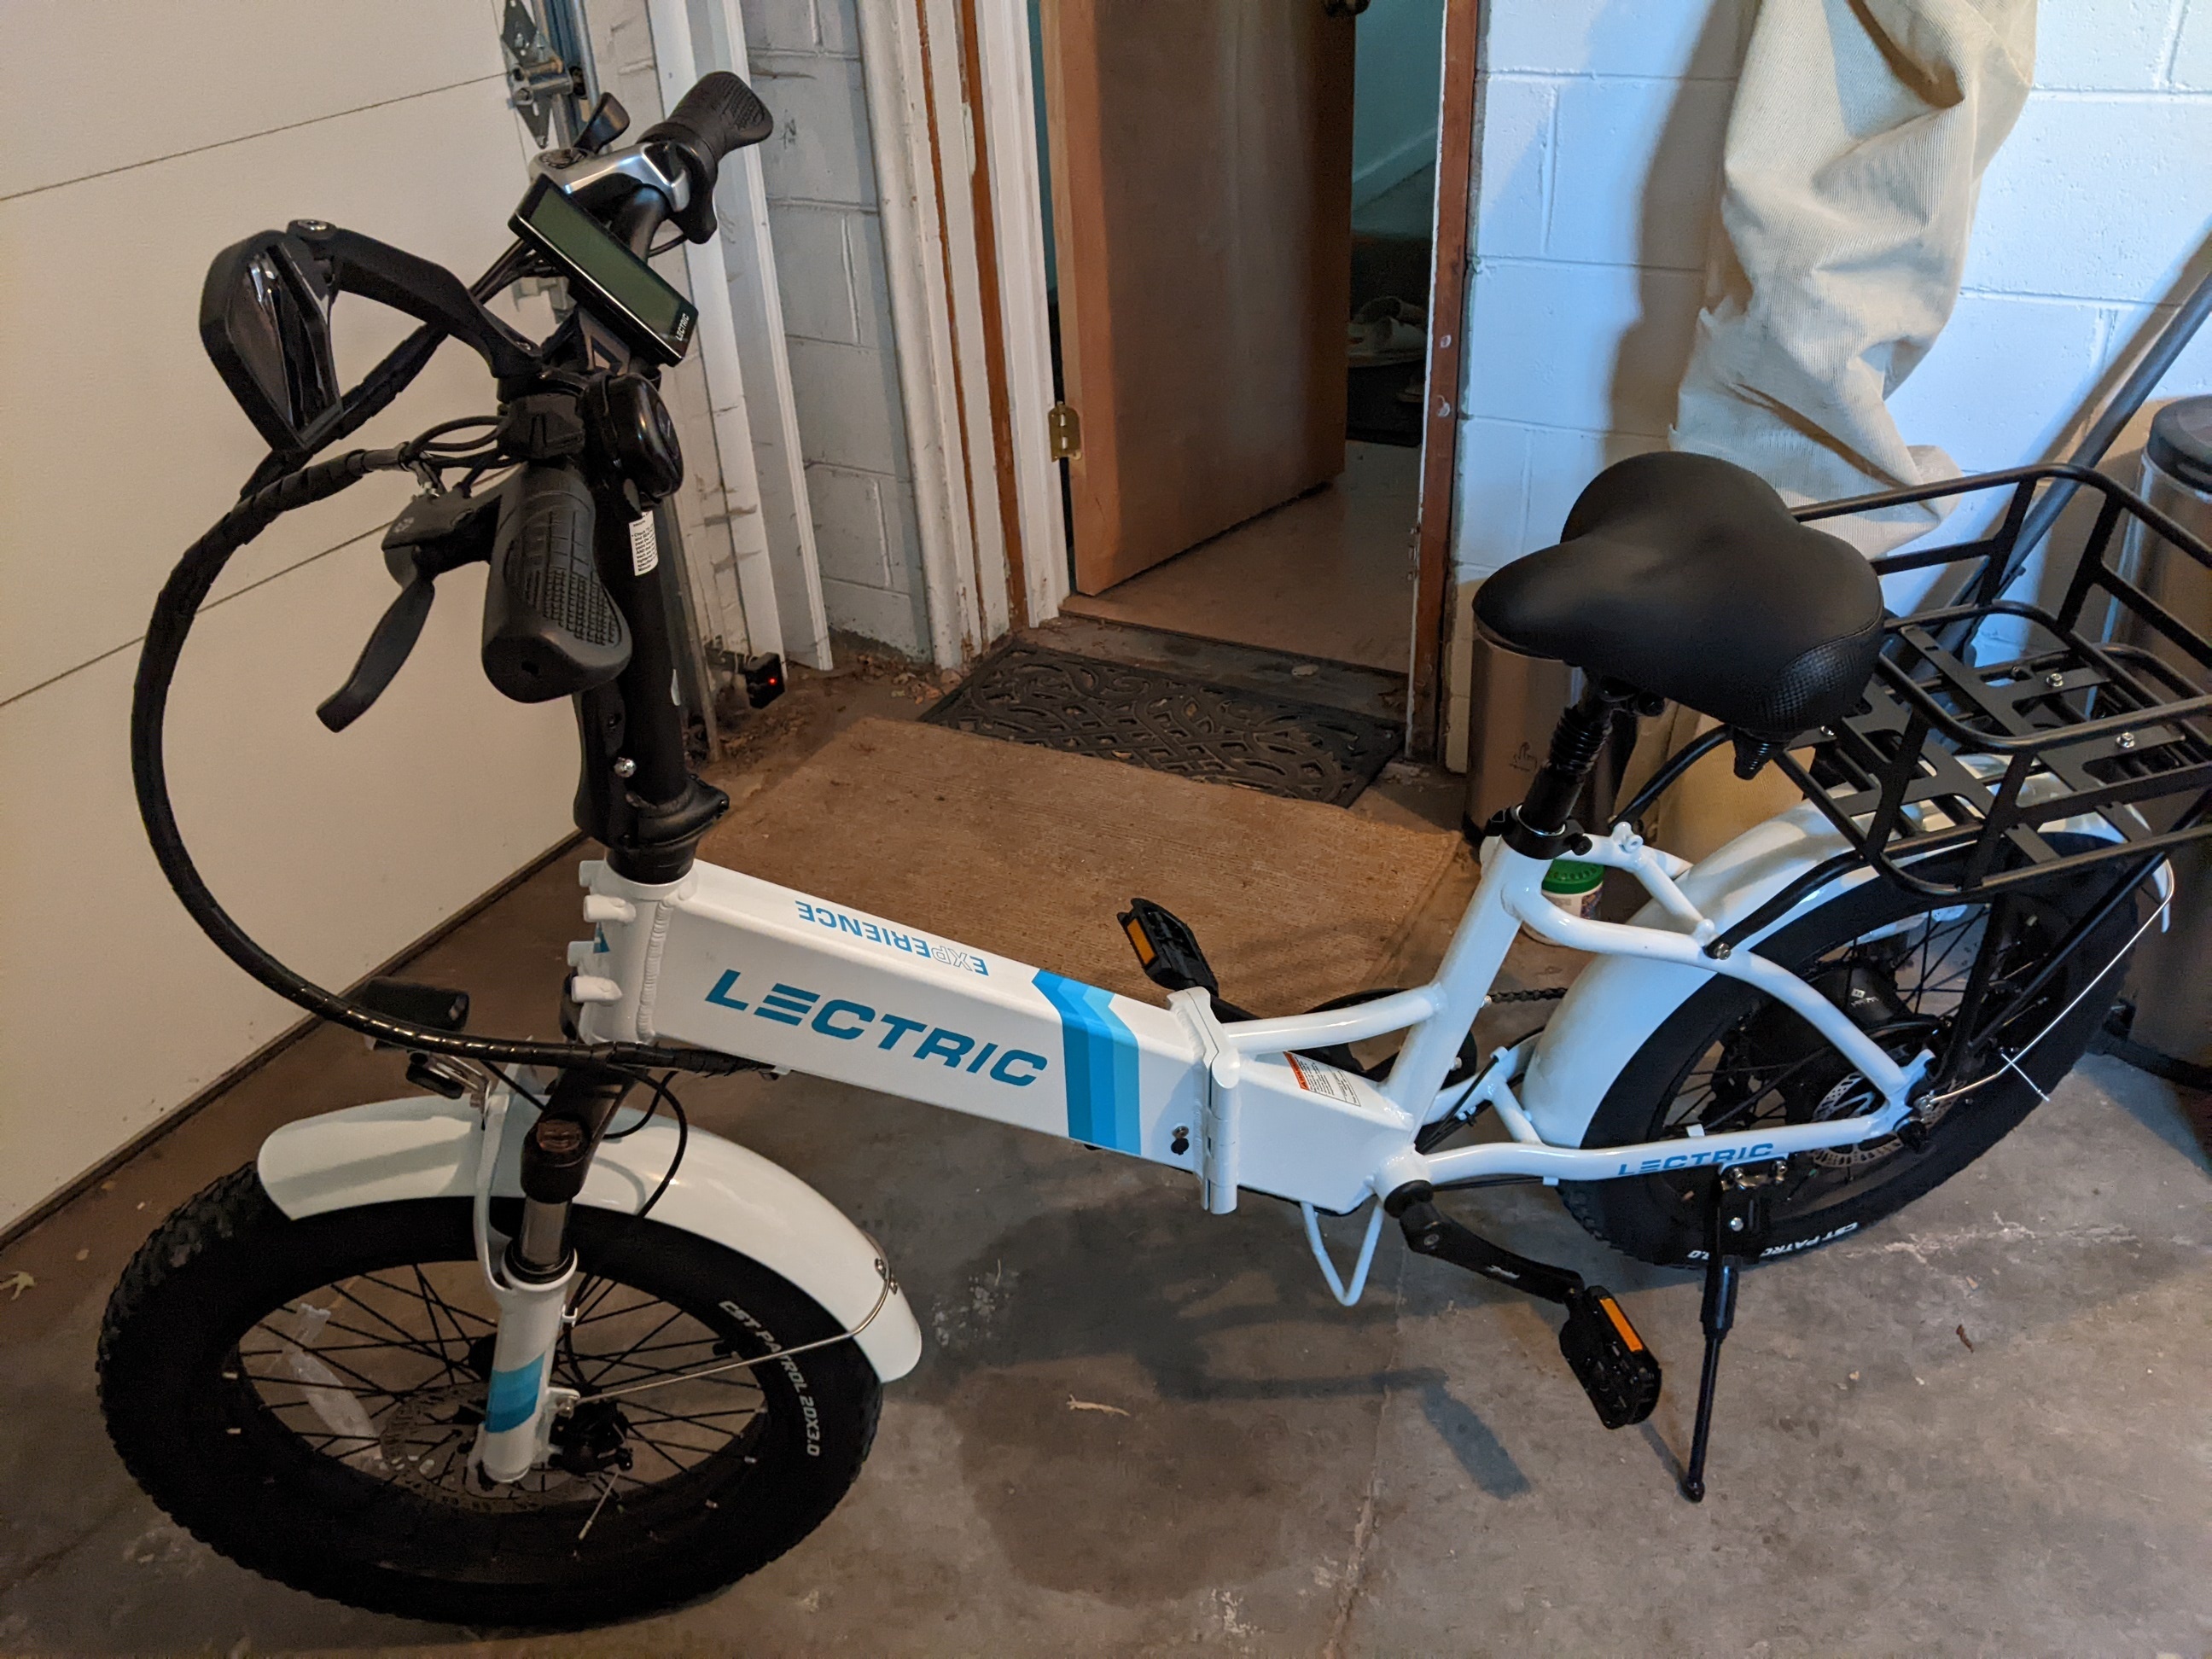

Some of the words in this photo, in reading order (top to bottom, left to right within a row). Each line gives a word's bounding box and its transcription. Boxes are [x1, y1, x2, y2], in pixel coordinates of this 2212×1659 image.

[675, 312, 690, 341] LECTRIC
[795, 900, 989, 975] EXPERIENCE
[705, 969, 1048, 1086] LECTRIC
[1618, 1143, 1773, 1175] LECTRIC
[1759, 1236, 1820, 1257] PATRO
[1822, 1222, 1859, 1242] CST
[719, 1301, 761, 1329] CST
[755, 1330, 808, 1393] PATROL
[799, 1396, 820, 1457] 20X3.0
